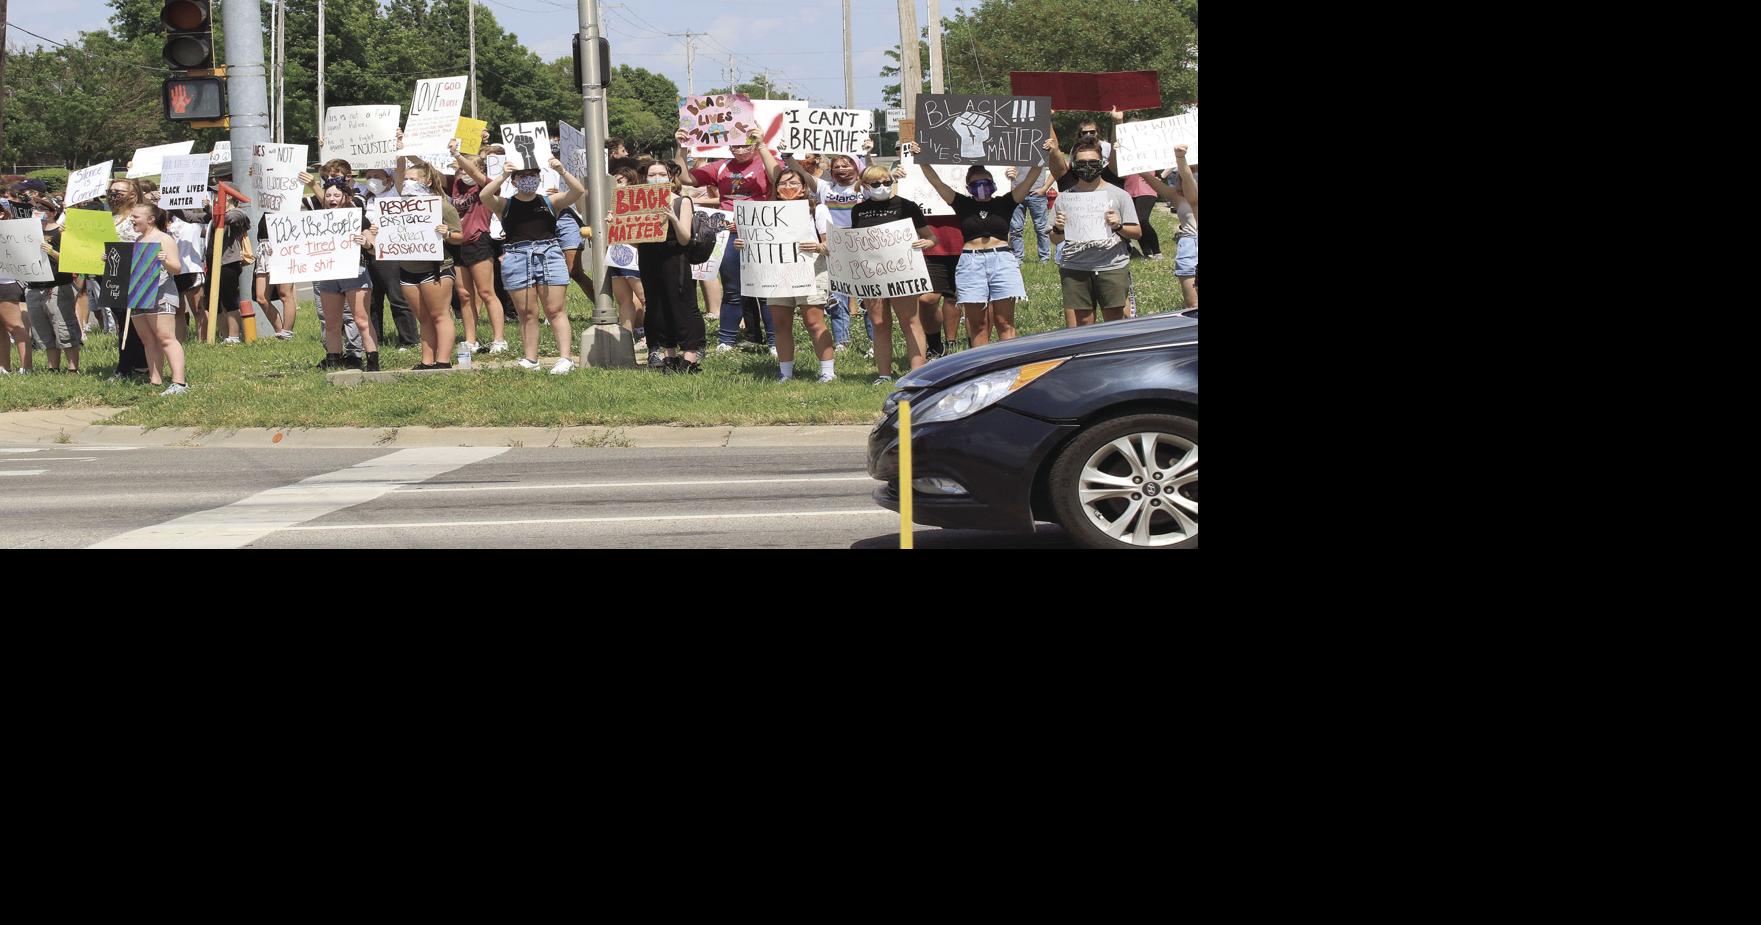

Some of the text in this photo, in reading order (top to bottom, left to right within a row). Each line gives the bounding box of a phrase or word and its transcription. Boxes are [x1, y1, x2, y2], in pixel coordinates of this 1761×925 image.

[410, 82, 461, 115] LOVE GOD
[698, 111, 733, 126] LIVES
[808, 110, 860, 128] CAN'T
[689, 121, 750, 145] MATTER
[919, 130, 961, 163] LIVES
[987, 126, 1045, 161] MATTER
[276, 147, 295, 163] NOT
[162, 184, 205, 195] BLACK LIVES
[169, 197, 193, 206] MATTER
[379, 199, 440, 215] RESPECT
[615, 188, 672, 214] BLACK
[736, 205, 789, 228] BLACK
[270, 216, 301, 244] We
[608, 222, 664, 245] MATTER
[739, 227, 776, 241] LIVES
[280, 233, 357, 257] are tired of
[287, 258, 336, 275] this shit
[854, 284, 882, 297] LIVES
